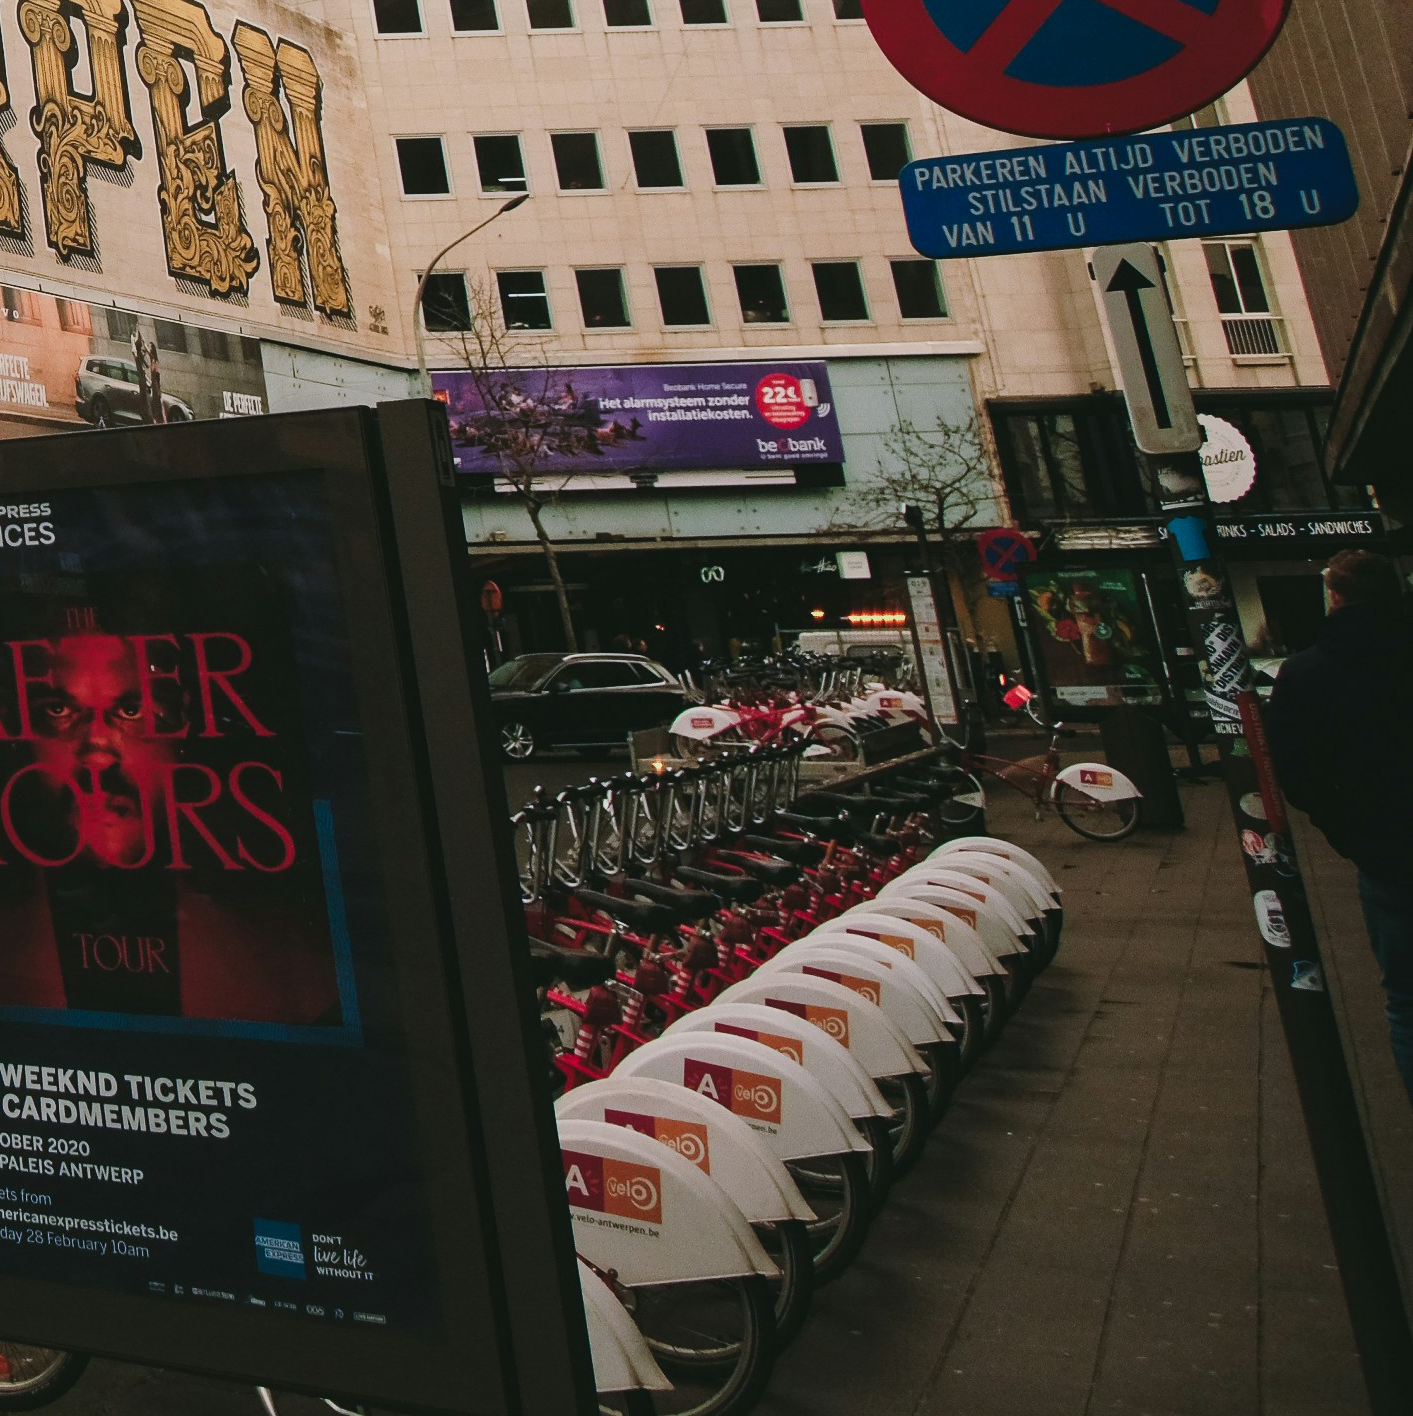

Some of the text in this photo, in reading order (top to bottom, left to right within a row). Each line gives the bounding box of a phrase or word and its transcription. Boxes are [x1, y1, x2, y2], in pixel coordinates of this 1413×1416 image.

[914, 124, 1325, 191] PARKEREN ALTIJD VERBODEN
[969, 161, 1278, 216] STILSTAAN VERBODEN
[942, 189, 1321, 249] VAN 11 U TOT 18 U
[223, 390, 263, 415] DE PERFECTE
[599, 394, 750, 410] Het alarmsysteem zonder
[648, 409, 753, 422] installatiekosten.
[1199, 448, 1246, 466] astien
[1258, 521, 1296, 538] SALADS
[1307, 520, 1372, 536] SANDWICHES
[1084, 773, 1093, 781] A
[72, 933, 170, 974] TOUR
[124, 1074, 258, 1110] TICKETS
[696, 1073, 778, 1113] A velo
[2, 1092, 231, 1139] CARDMEMBERS
[47, 1137, 91, 1157] 2020
[59, 1161, 145, 1185] ANTWERP
[20, 1188, 53, 1206] from
[565, 1164, 657, 1211] A velo
[26, 1229, 44, 1244] 28
[47, 1232, 107, 1256] February
[111, 1240, 150, 1258] 10am
[255, 1235, 300, 1252] AMERICAN
[312, 1233, 342, 1245] DON'T
[264, 1248, 305, 1264] EXPRESS
[314, 1245, 368, 1269] live life
[316, 1266, 374, 1281] WITHOUT IT
